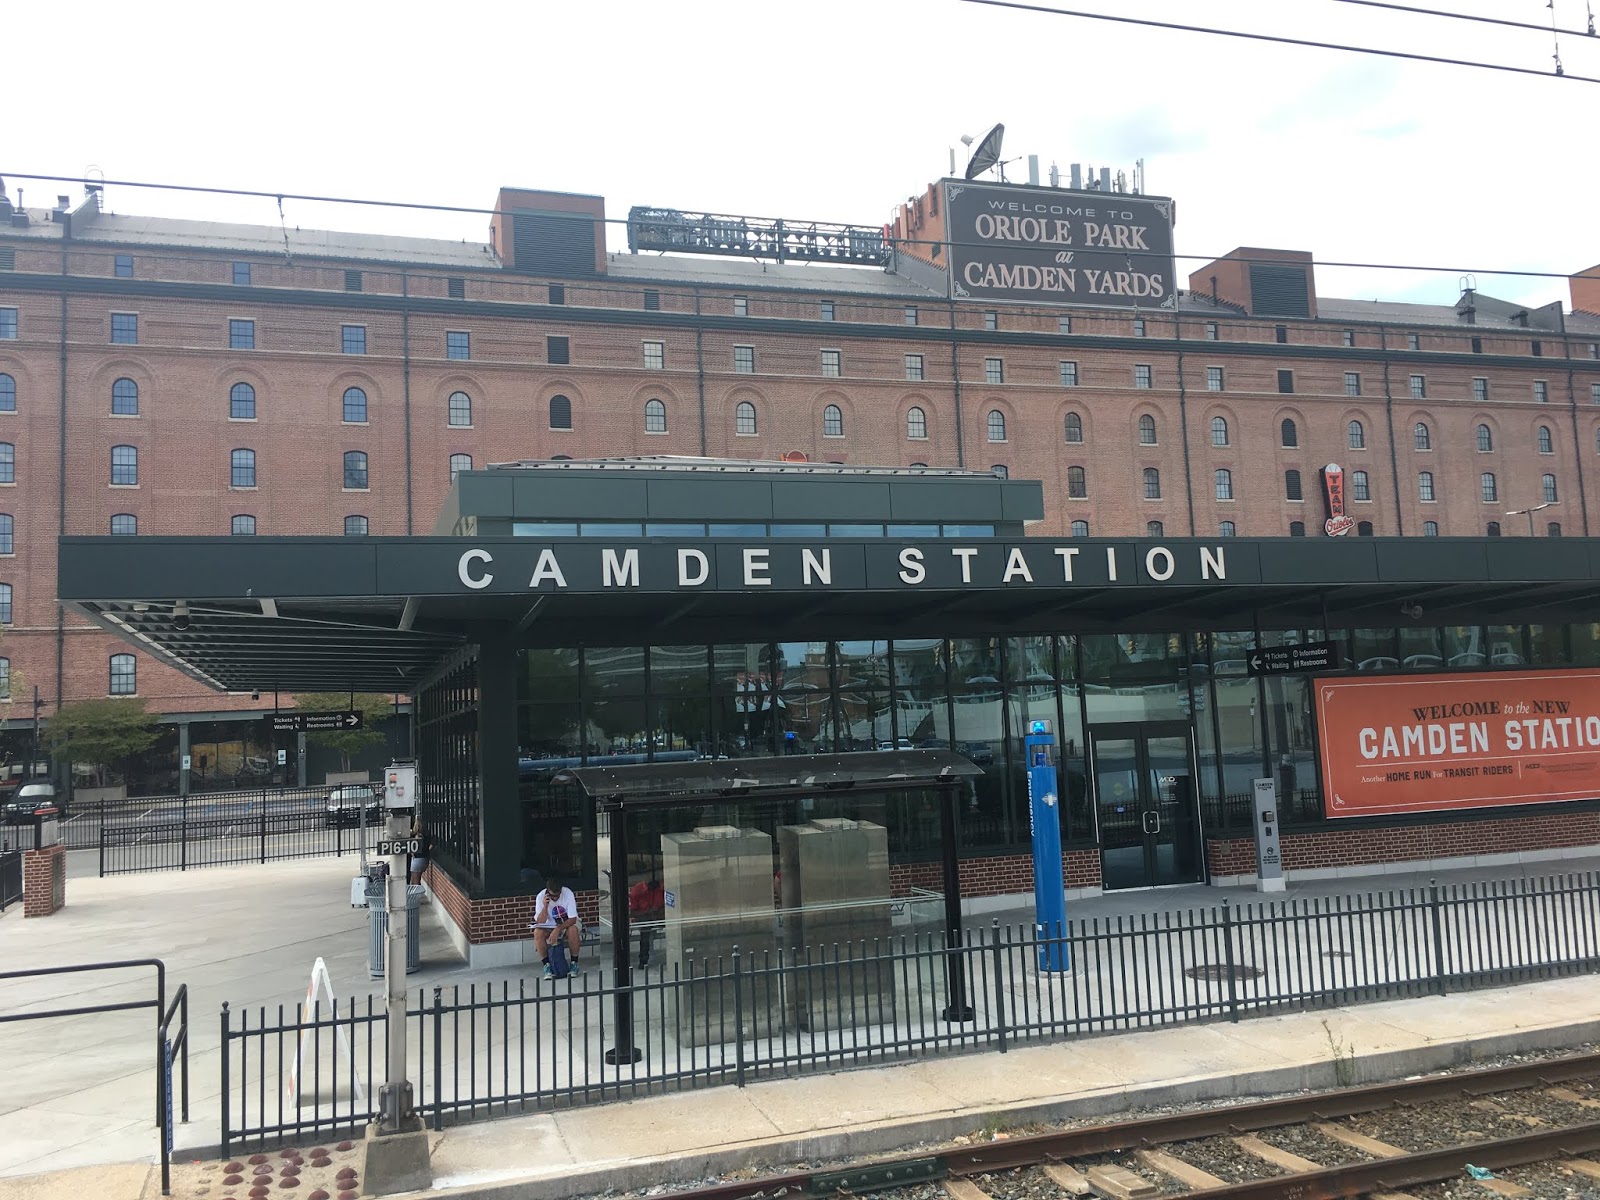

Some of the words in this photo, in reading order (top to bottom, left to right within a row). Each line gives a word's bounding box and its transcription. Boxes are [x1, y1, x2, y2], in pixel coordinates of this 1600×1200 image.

[988, 200, 1096, 217] WELCOME
[1107, 210, 1133, 220] TO
[975, 213, 1072, 245] ORIOLE
[1084, 222, 1149, 250] PARK
[1055, 250, 1075, 264] at
[964, 261, 1076, 292] CAMDEN
[1083, 269, 1164, 298] YARDS
[1330, 475, 1342, 513] TEAM
[457, 548, 832, 589] CAMDEN
[898, 546, 1226, 585] STATION
[1299, 648, 1328, 657] Information
[1300, 658, 1327, 667] Restrooms
[1413, 700, 1500, 721] WELCOME
[1503, 703, 1514, 715] to
[1515, 701, 1530, 715] the
[1533, 700, 1571, 715] NEW
[1359, 721, 1489, 759] CAMDEN
[1361, 774, 1385, 784] Another
[1386, 771, 1411, 782] HOME
[1413, 769, 1431, 780] RUN
[1443, 767, 1479, 779] TRANSIT
[1483, 765, 1513, 776] RIDERS
[381, 840, 419, 855] P16-10
